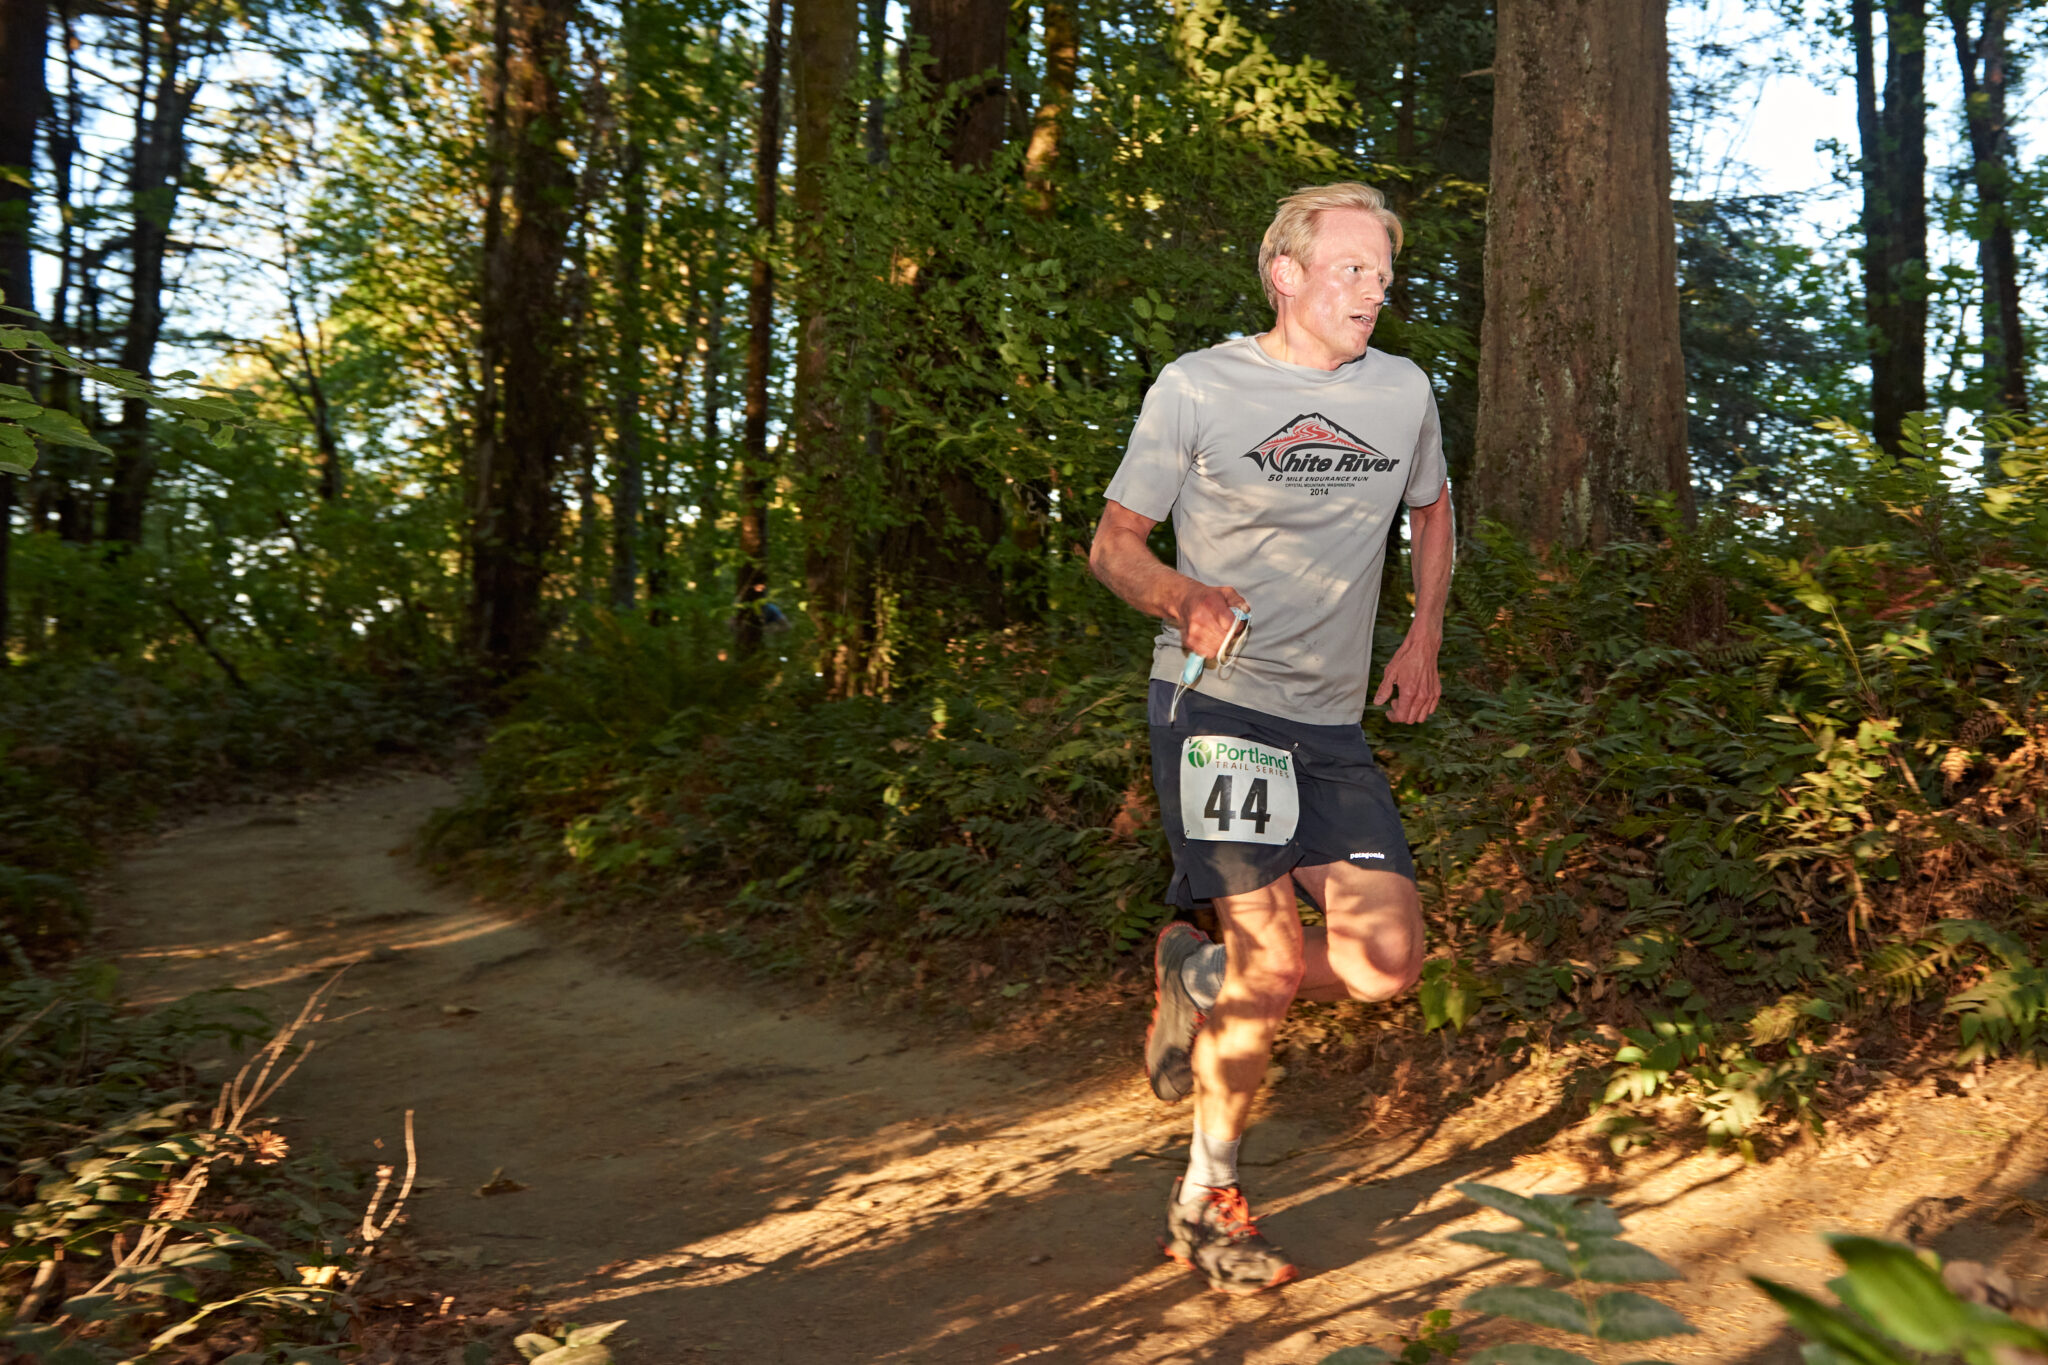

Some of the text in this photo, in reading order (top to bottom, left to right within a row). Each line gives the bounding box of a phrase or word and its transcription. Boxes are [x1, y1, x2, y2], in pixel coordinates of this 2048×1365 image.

[1240, 448, 1400, 473] White River
[1267, 473, 1283, 482] 50
[1310, 488, 1329, 496] 2014
[1215, 743, 1289, 771] Portland
[1215, 761, 1290, 779] TRAIL SERIES
[1203, 774, 1272, 834] 44
[1350, 852, 1385, 860] patagonia
